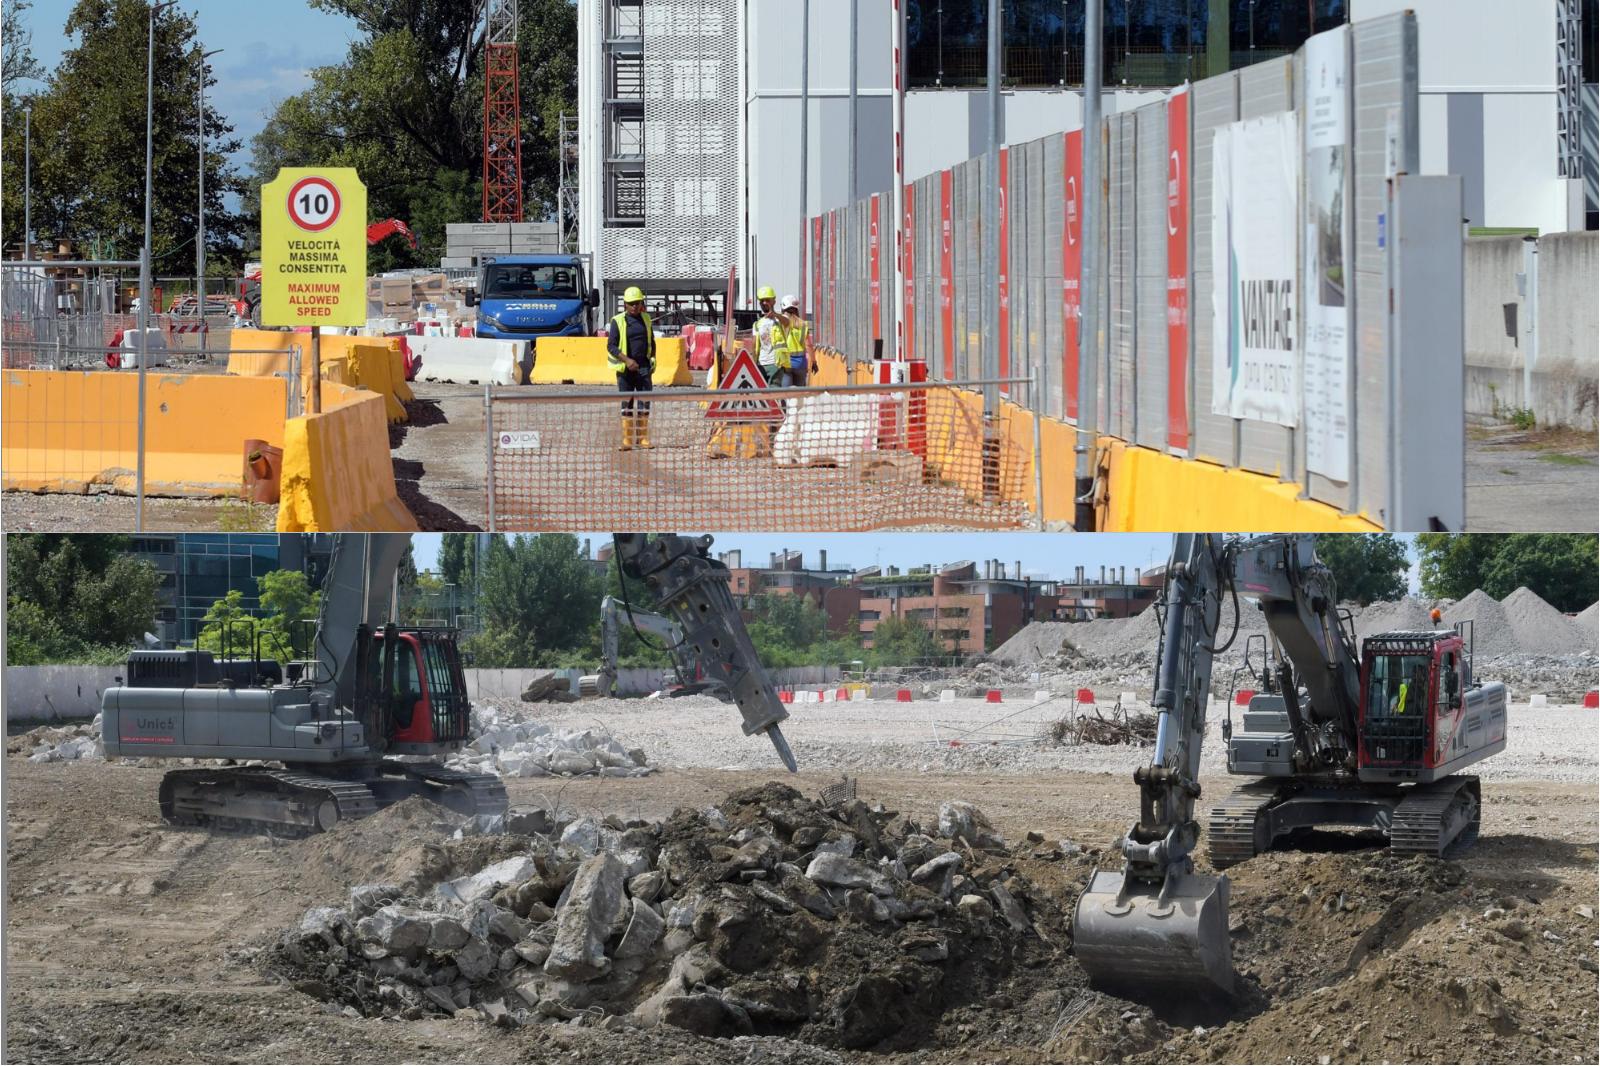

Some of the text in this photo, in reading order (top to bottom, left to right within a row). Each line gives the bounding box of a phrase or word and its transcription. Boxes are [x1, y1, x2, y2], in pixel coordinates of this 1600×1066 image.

[299, 193, 329, 215] 10
[289, 252, 339, 262] MASSIMA
[279, 264, 348, 274] CONSENTITA
[288, 284, 341, 293] MAXIMUM
[288, 295, 340, 305] ALLOWED
[296, 307, 332, 317] SPEED
